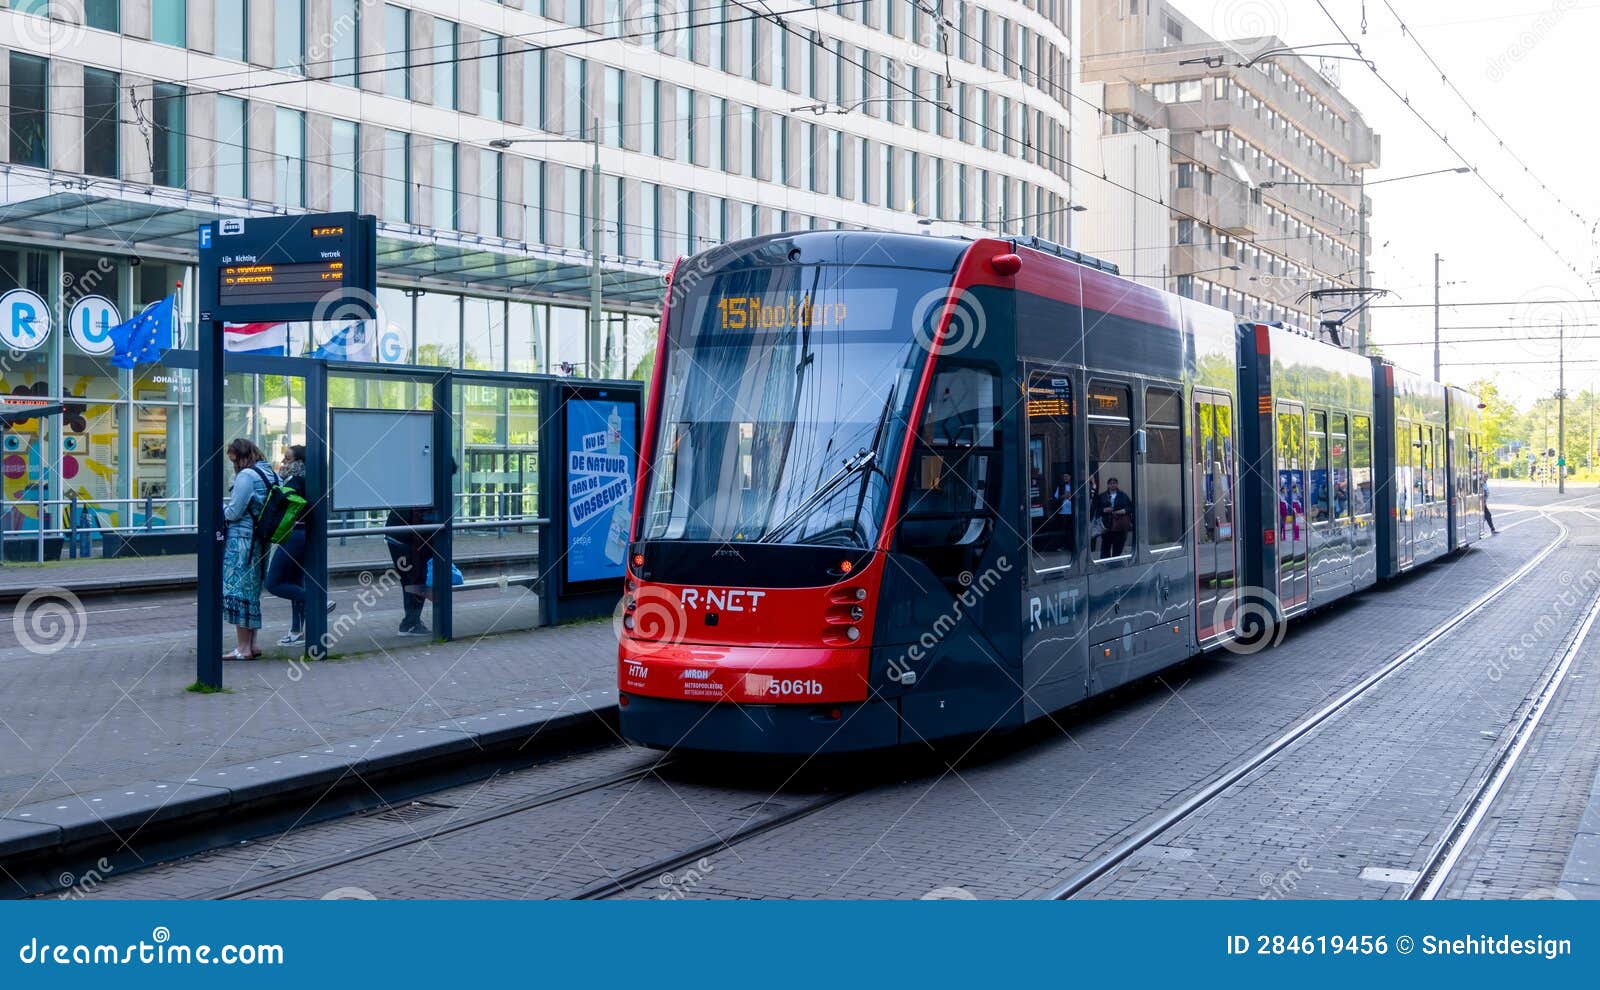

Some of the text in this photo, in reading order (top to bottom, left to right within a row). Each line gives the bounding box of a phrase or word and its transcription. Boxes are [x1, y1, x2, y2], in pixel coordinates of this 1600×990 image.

[201, 229, 211, 246] F
[235, 254, 257, 263] Richting
[320, 250, 341, 258] Vertrek
[11, 302, 36, 338] R
[717, 297, 747, 329] 15
[82, 306, 109, 344] U
[380, 332, 402, 362] G
[152, 375, 192, 384] JOHANES
[585, 434, 605, 450] NU IS
[572, 455, 626, 474] DE NATUUR
[571, 476, 598, 496] AAN DE
[573, 478, 629, 522] WASBEURT
[628, 665, 649, 679] HTM
[769, 679, 823, 695] 5061b
